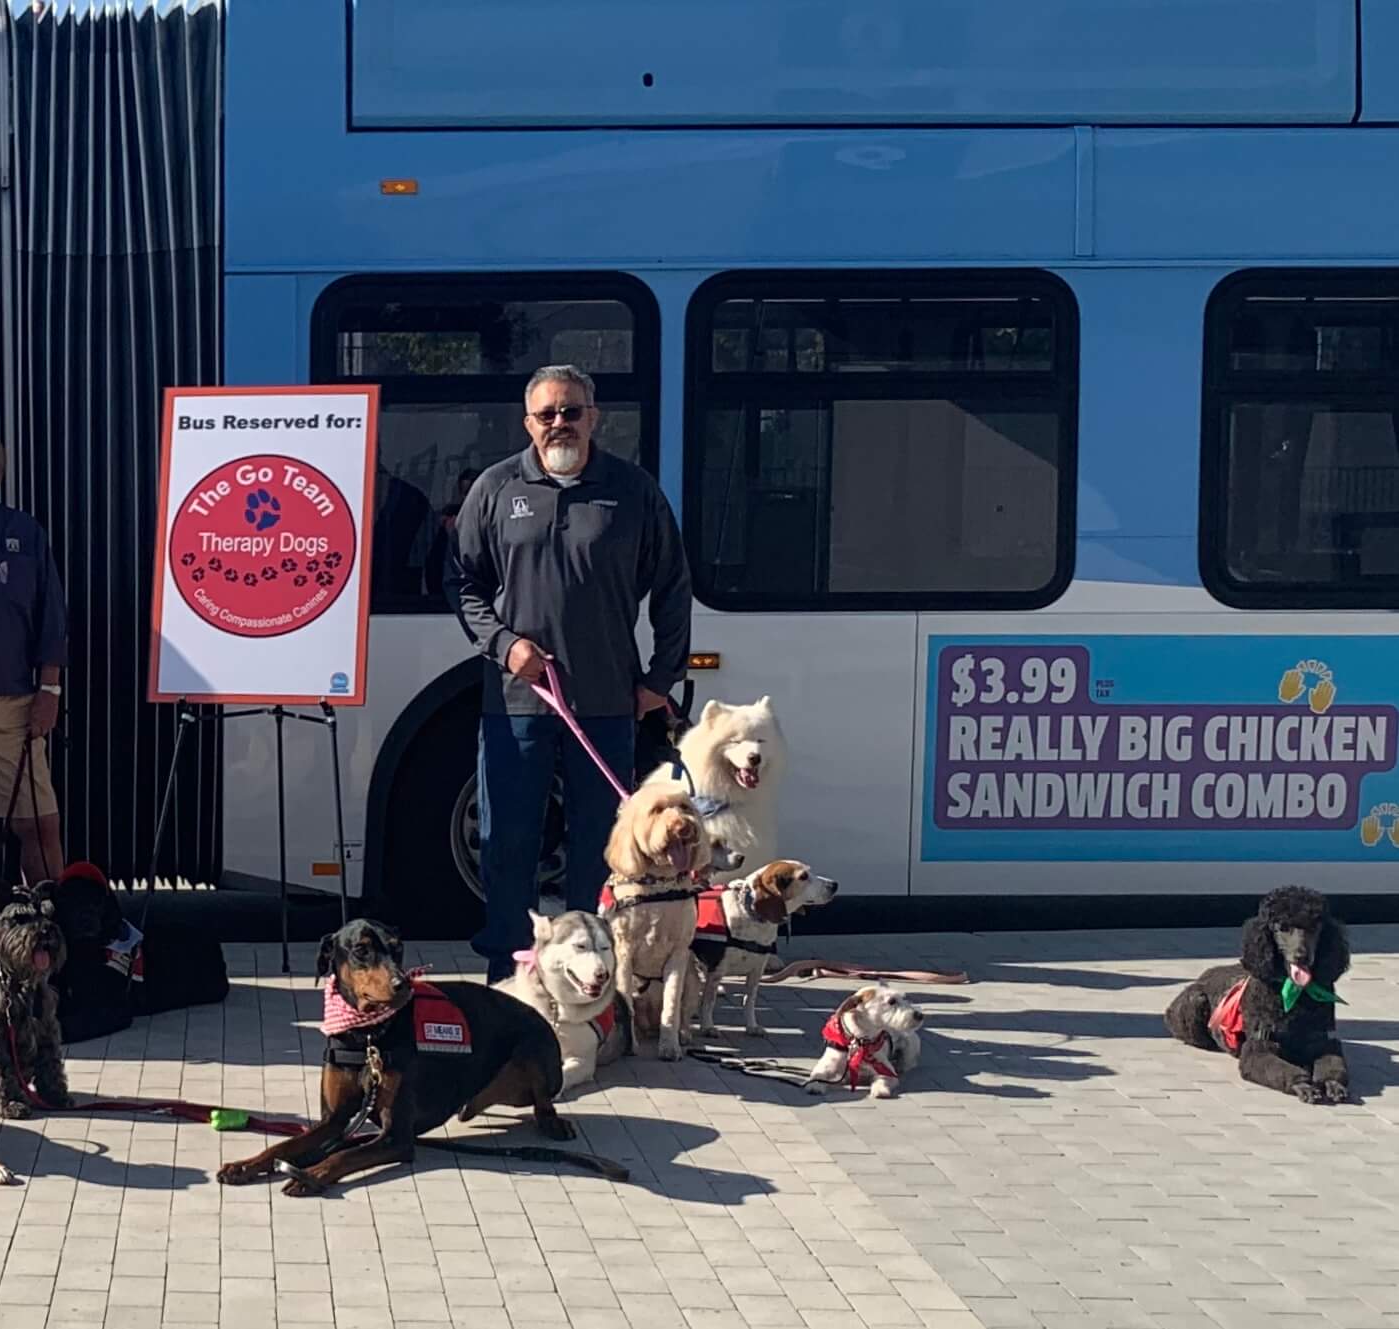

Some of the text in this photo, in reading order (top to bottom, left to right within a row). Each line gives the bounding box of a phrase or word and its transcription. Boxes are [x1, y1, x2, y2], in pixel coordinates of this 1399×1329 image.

[178, 414, 362, 430] Bus Reserved for:
[188, 465, 335, 517] The Go Team
[198, 532, 329, 557] Therapy Dogs
[194, 588, 328, 628] Caring Compassionate Canines
[950, 654, 1077, 707] $3.99
[948, 714, 1388, 762] REALLY BIG CHICKEN
[946, 772, 1347, 819] SANDWICH COMBO
